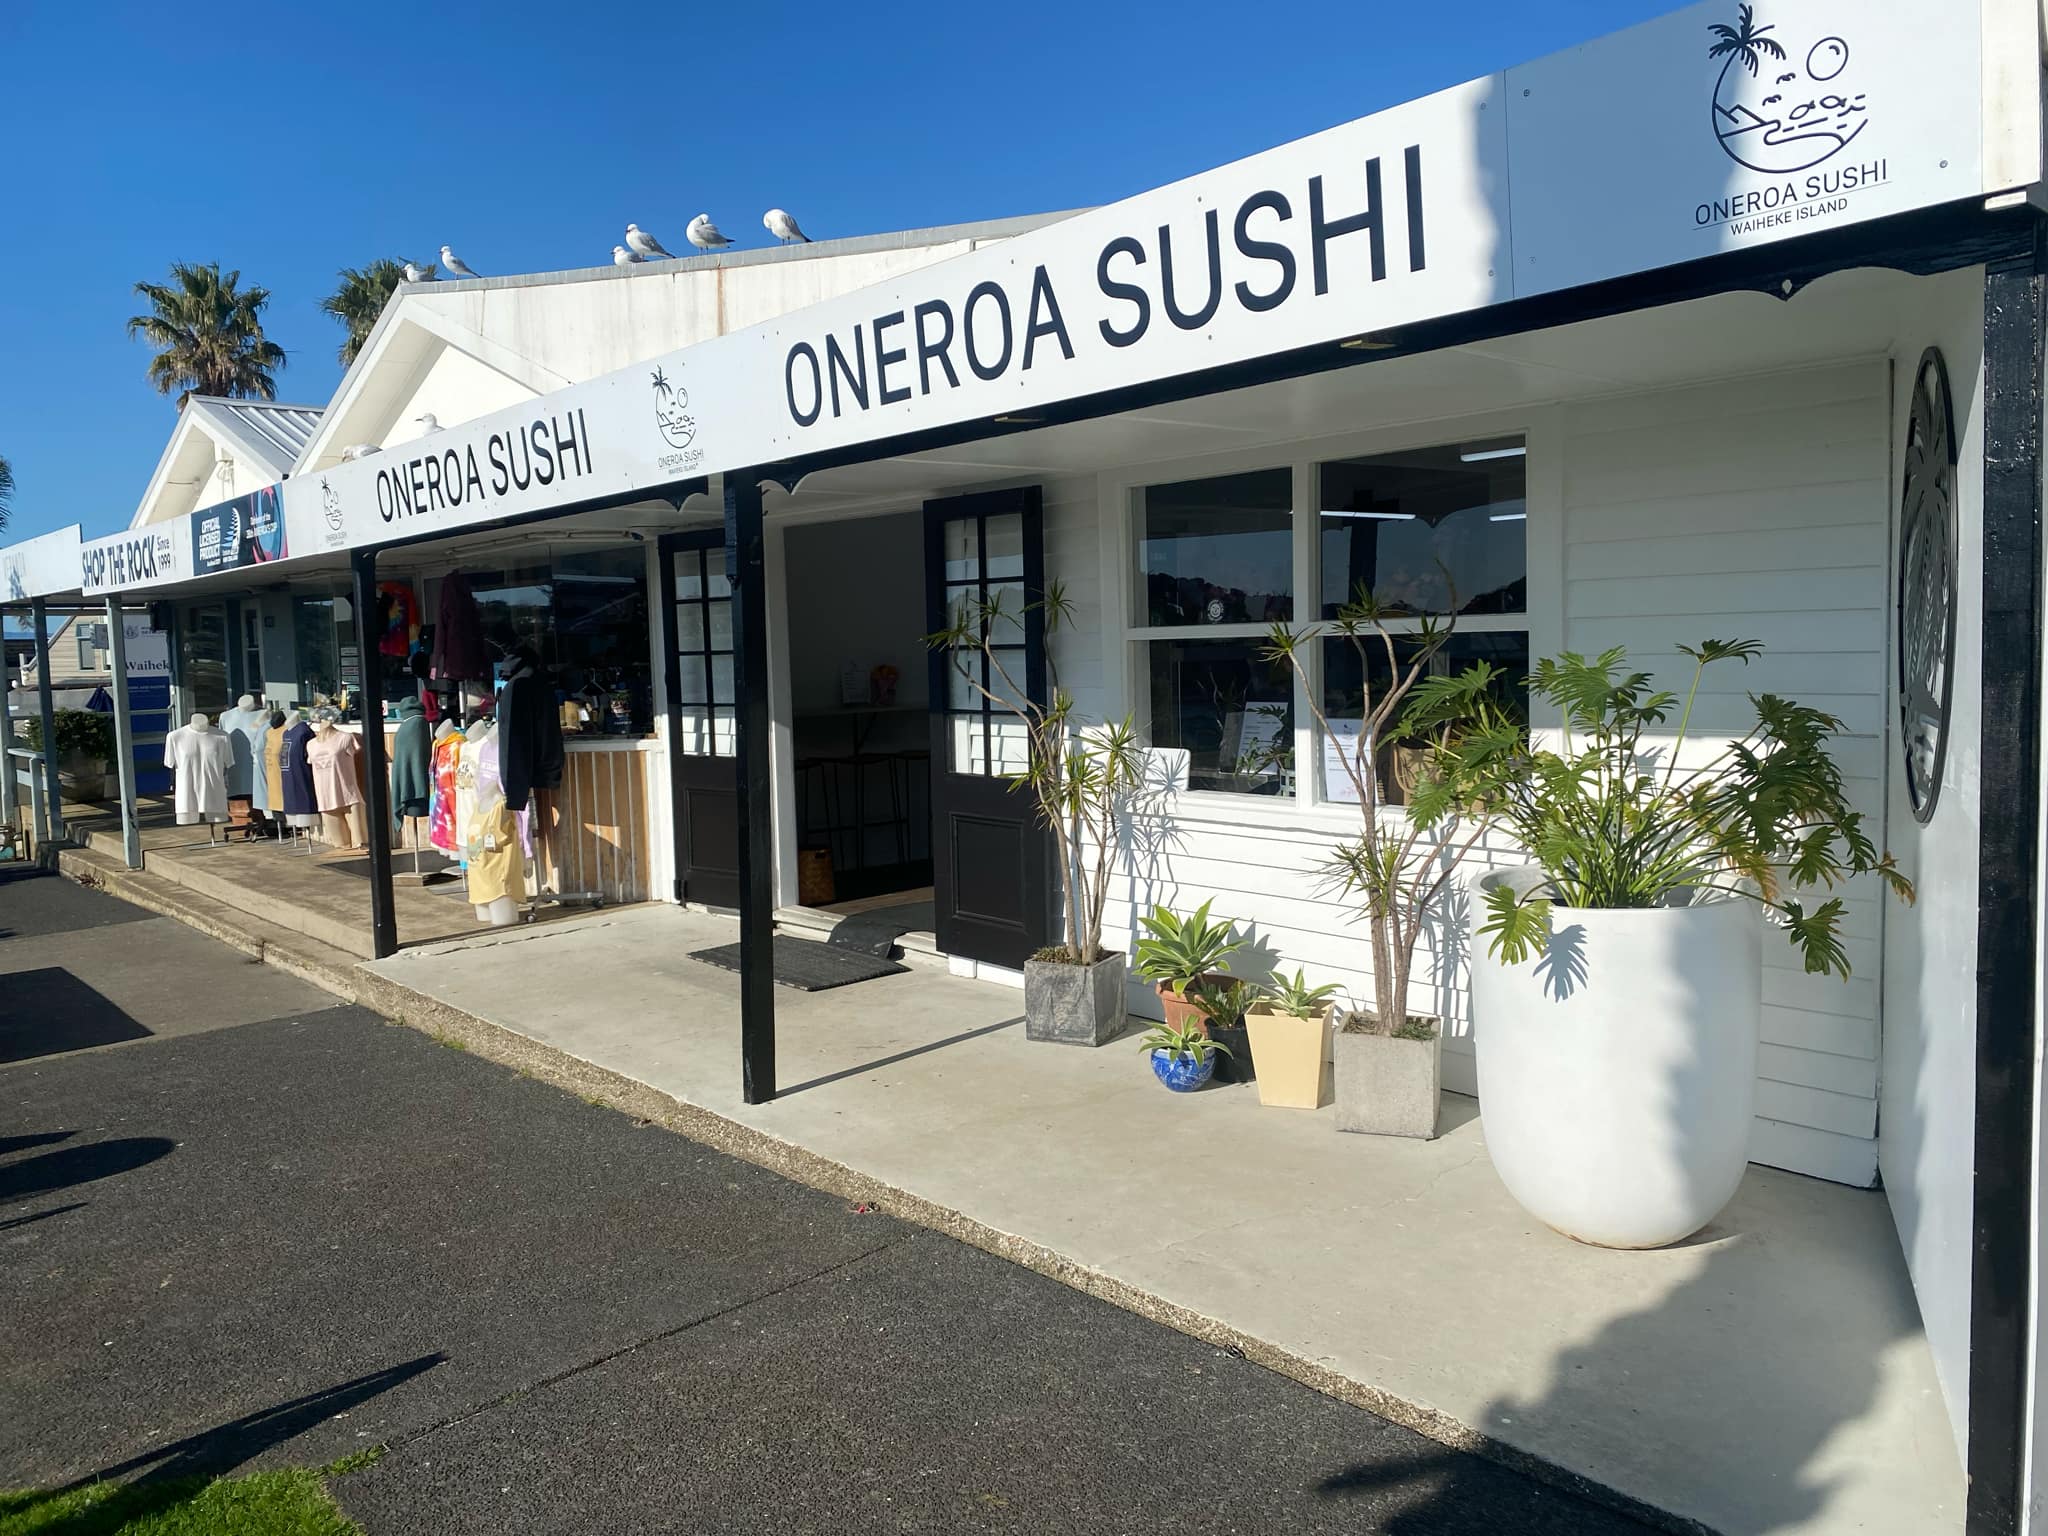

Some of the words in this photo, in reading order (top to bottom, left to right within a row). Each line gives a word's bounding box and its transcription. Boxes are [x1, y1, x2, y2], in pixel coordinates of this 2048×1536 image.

[1695, 182, 1798, 225] ONEROA
[1805, 158, 1888, 198] SUSHI
[1730, 210, 1793, 236] WAIHEKE
[1796, 198, 1848, 221] ISLAND
[785, 265, 1075, 427] ONEROA
[1096, 144, 1426, 347] SUSHI
[376, 443, 486, 523] ONEROA
[488, 408, 593, 497] SUSHI
[658, 453, 684, 468] ONEROA
[684, 448, 704, 462] SUSHI
[82, 547, 105, 588] SHOP
[107, 543, 126, 586] THE
[126, 534, 158, 583] ROCK
[156, 536, 170, 551] Since
[158, 552, 171, 570] 1999
